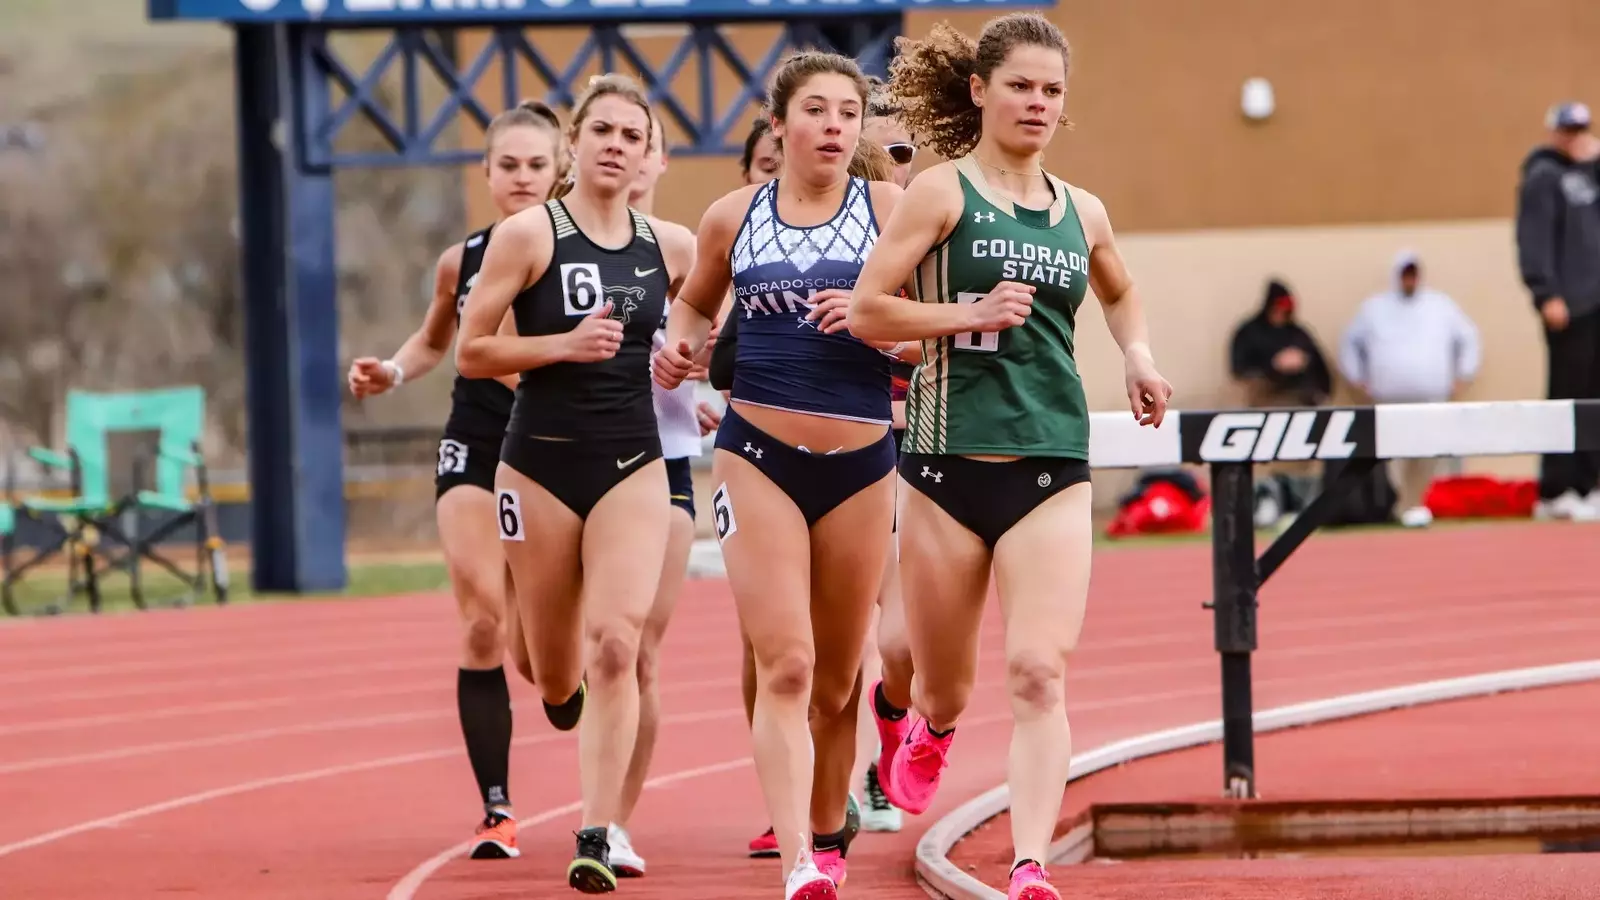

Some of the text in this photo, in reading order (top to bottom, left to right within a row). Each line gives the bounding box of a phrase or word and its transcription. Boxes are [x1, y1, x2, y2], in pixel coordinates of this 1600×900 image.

[972, 239, 1088, 276] COLORADO
[1002, 260, 1072, 289] STATE
[567, 267, 597, 311] 6
[740, 288, 819, 319] MIN
[1199, 410, 1357, 462] GILL
[499, 493, 519, 537] 6
[713, 489, 730, 540] 5
